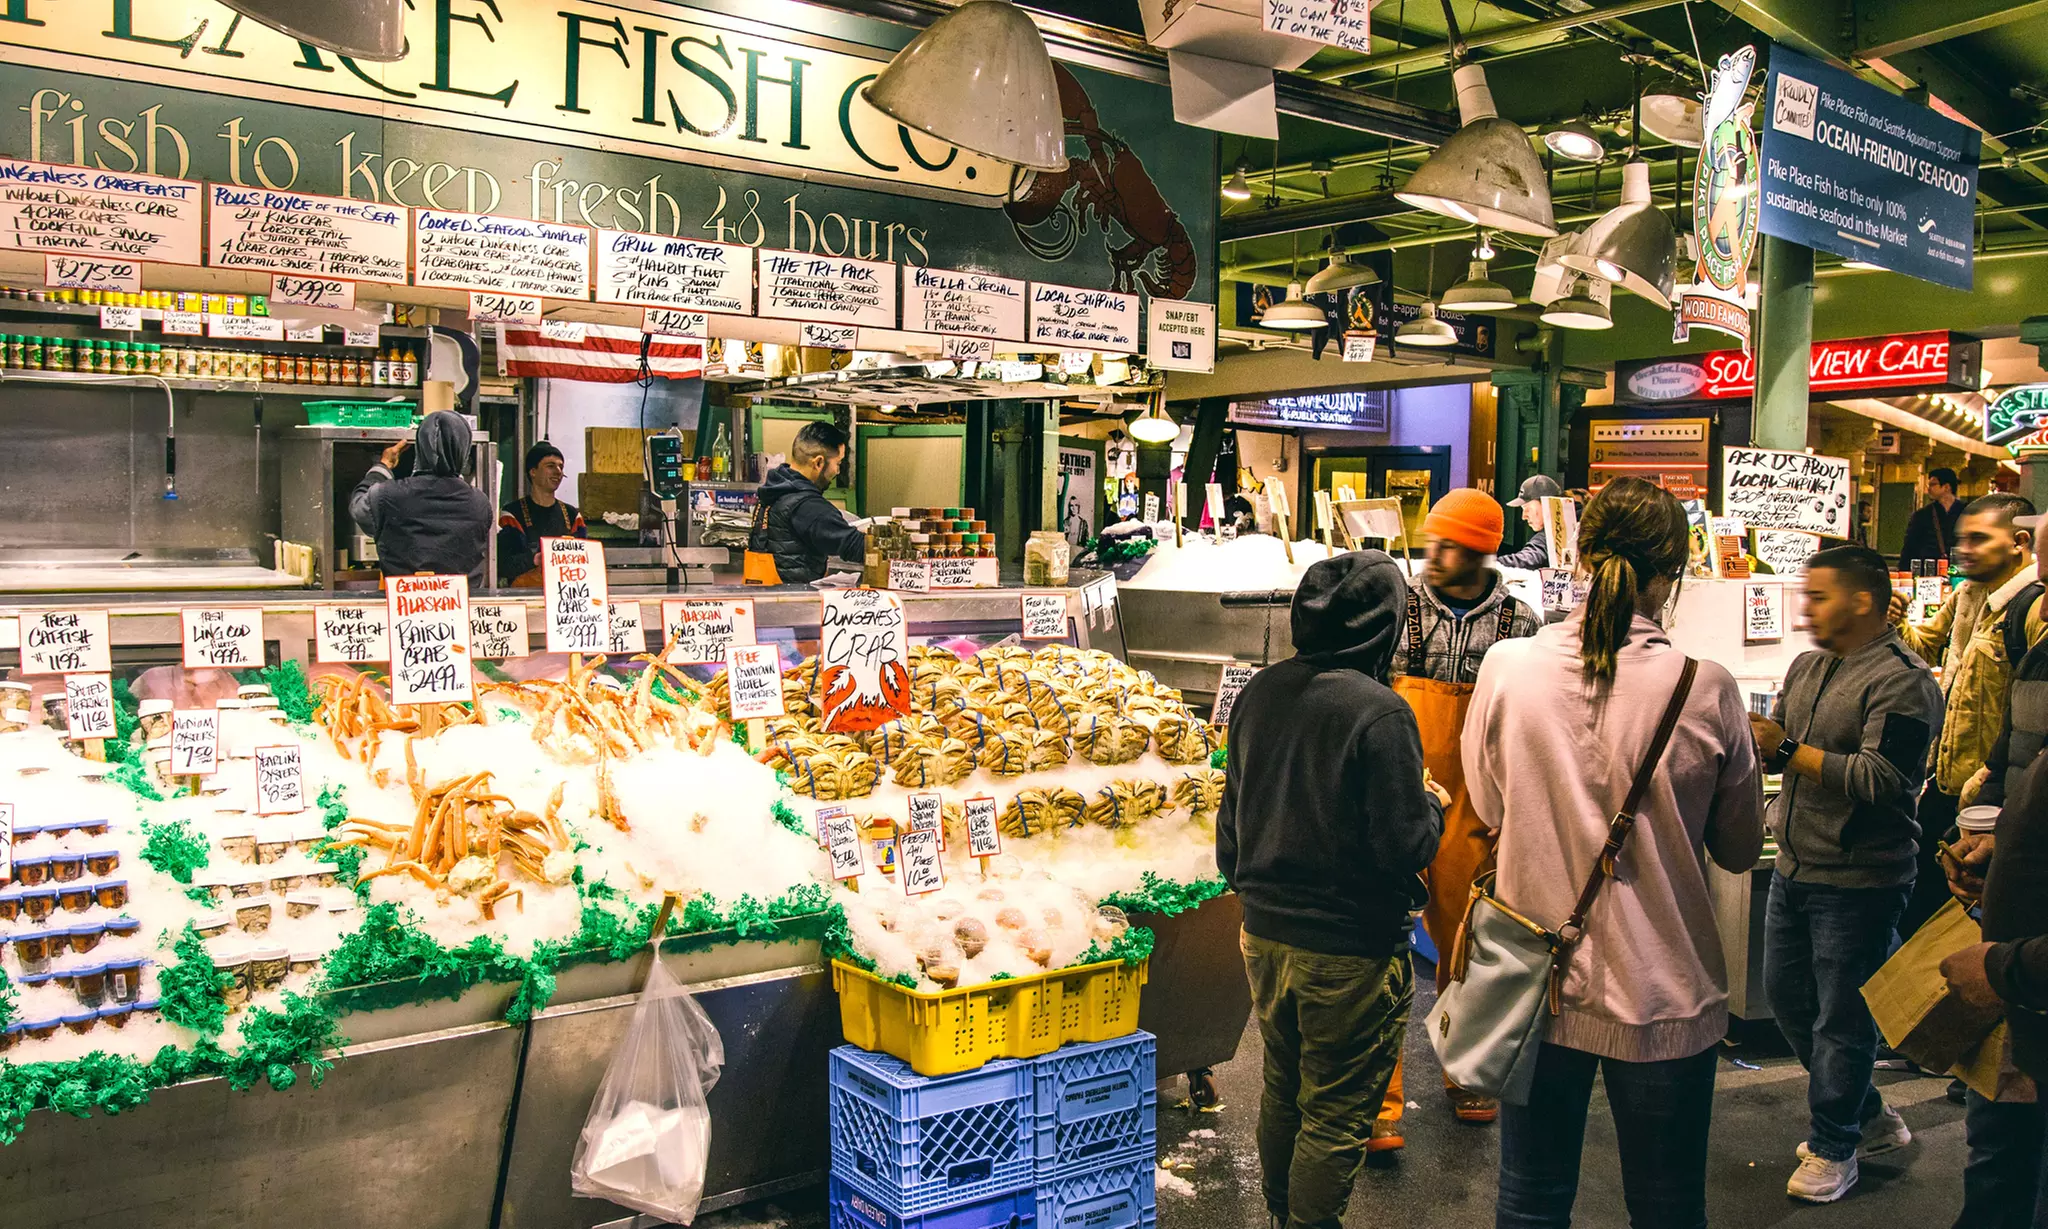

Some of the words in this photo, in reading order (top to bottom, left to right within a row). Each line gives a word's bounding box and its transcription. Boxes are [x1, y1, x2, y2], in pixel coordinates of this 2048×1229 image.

[1269, 0, 1293, 15] YOU
[1300, 6, 1327, 22] CAN
[1333, 14, 1366, 30] TAKE
[1271, 16, 1288, 30] IT
[1290, 22, 1307, 33] ON
[1310, 26, 1333, 40] THE
[1336, 31, 1368, 48] PLANE
[556, 11, 811, 151] FISH
[1820, 92, 1836, 111] Pike
[1836, 98, 1855, 118] Place
[1854, 106, 1868, 123] Fish
[1869, 113, 1883, 128] and
[1883, 118, 1906, 139] Seattle
[1906, 128, 1937, 154] Aquarium
[1936, 142, 1962, 162] Support
[1816, 120, 1917, 178] OCEAN-FRIENDLY
[1918, 160, 1969, 197] SEAFOOD
[18, 87, 191, 183] fish
[216, 116, 300, 192] to
[335, 131, 501, 214] keep
[524, 160, 682, 236] fresh
[702, 186, 766, 247] 48
[783, 193, 930, 267] hours
[94, 174, 196, 199] CRABFEAST
[1768, 158, 1787, 181] Pike
[1790, 166, 1812, 190] Place
[1814, 175, 1832, 196] Fish
[1834, 180, 1848, 201] has
[1850, 187, 1864, 207] the
[1866, 193, 1884, 216] only
[1886, 200, 1908, 220] 100%
[36, 204, 76, 220] CRAB
[55, 189, 134, 212] DUNGENESS
[135, 201, 178, 218] CRAB
[266, 210, 300, 224] KING
[300, 214, 332, 228] CRAB
[361, 206, 400, 226] SEA
[1766, 191, 1818, 219] sustainable
[1820, 205, 1854, 230] seafood
[1856, 217, 1864, 232] in
[1866, 220, 1879, 238] the
[1880, 225, 1908, 247] Market
[30, 218, 105, 236] COCKTAIL
[109, 226, 166, 244] SAUCE
[261, 222, 322, 237] LOBSTER
[536, 224, 588, 246] SAMPLER
[29, 236, 94, 248] TARTAR
[100, 240, 151, 255] SAUCE
[236, 240, 268, 254] CRAB
[440, 234, 478, 248] WHOLE
[543, 243, 570, 257] CRAB
[612, 233, 658, 252] GRILL
[664, 242, 726, 264] MASTER
[638, 257, 686, 276] HALIBUT
[692, 266, 730, 278] FILLET
[764, 256, 802, 274] THE
[429, 270, 472, 284] COCKTAIL
[637, 273, 668, 288] KING
[780, 276, 839, 290] TRADITIONAL
[841, 282, 879, 294] SMOKED
[915, 268, 966, 290] PAELLA
[968, 276, 1020, 296] SPECIAL
[626, 285, 646, 300] PIKE
[672, 294, 691, 304] FISH
[694, 296, 742, 310] SEASONING
[780, 287, 812, 298] GARLIC
[1036, 286, 1072, 304] LOCAL
[1075, 292, 1126, 312] SHIPPING
[784, 298, 827, 310] SALMON
[830, 302, 862, 316] CANDY
[1166, 310, 1199, 322] SNAP/EBT
[1684, 299, 1716, 320] WORLD
[1718, 304, 1750, 333] FAMOUS
[1088, 332, 1110, 342] MORE
[1158, 324, 1188, 334] ACCEPTED
[1190, 326, 1206, 336] HERE
[1810, 348, 1872, 377] VIEW
[1879, 341, 1949, 371] CAFE
[1290, 410, 1318, 422] PUBLIC
[1320, 412, 1352, 424] SEATING
[1060, 453, 1091, 468] EATHER
[1728, 450, 1768, 466] ASK
[1772, 452, 1800, 472] US
[1800, 457, 1849, 480] ABOUT
[1730, 470, 1778, 488] LOCAL
[1767, 492, 1818, 505] OVERNIGHT
[1773, 504, 1799, 513] YOUR
[552, 540, 586, 551] GENUINE
[1760, 532, 1774, 544] WE
[1782, 534, 1812, 546] SHIP
[550, 551, 590, 567] ALASKAN
[560, 566, 586, 582] RED
[396, 577, 453, 592] GENUINE
[558, 582, 590, 602] KING
[1752, 586, 1766, 597] WE
[396, 590, 462, 616] ALASKAN
[558, 600, 588, 614] CRAB
[1749, 596, 1770, 608] SHIP
[40, 612, 80, 628] FRESH
[680, 608, 722, 623] ALASKAN
[822, 604, 902, 628] DUNGENESS
[193, 626, 223, 642] LING
[226, 624, 250, 638] COD
[324, 622, 388, 638] ROCKFISH
[395, 619, 456, 650] BAIRDI
[497, 620, 518, 634] COD
[698, 617, 734, 636] SALMON
[28, 627, 94, 648] CATFISH
[404, 644, 448, 668] CRAB
[734, 651, 760, 666] FREE
[828, 628, 898, 672] CRAB
[398, 664, 456, 692] $24.99
[734, 678, 770, 690] HOTEL
[66, 681, 107, 698] SALTED
[69, 698, 108, 714] HERRING
[175, 731, 216, 745] OYSTERS
[260, 766, 300, 783] OYSTERS
[828, 818, 854, 839] OYSTER
[902, 830, 934, 844] FRESH!
[906, 844, 923, 856] AHI
[913, 855, 934, 866] POKE
[1084, 1085, 1112, 1098] BROTHERS
[1112, 1081, 1129, 1092] SMITH
[1065, 1092, 1084, 1102] FARMS
[1084, 1206, 1112, 1218] BROTHERS
[1112, 1201, 1128, 1211] SMITH
[1064, 1214, 1084, 1224] FARMS
